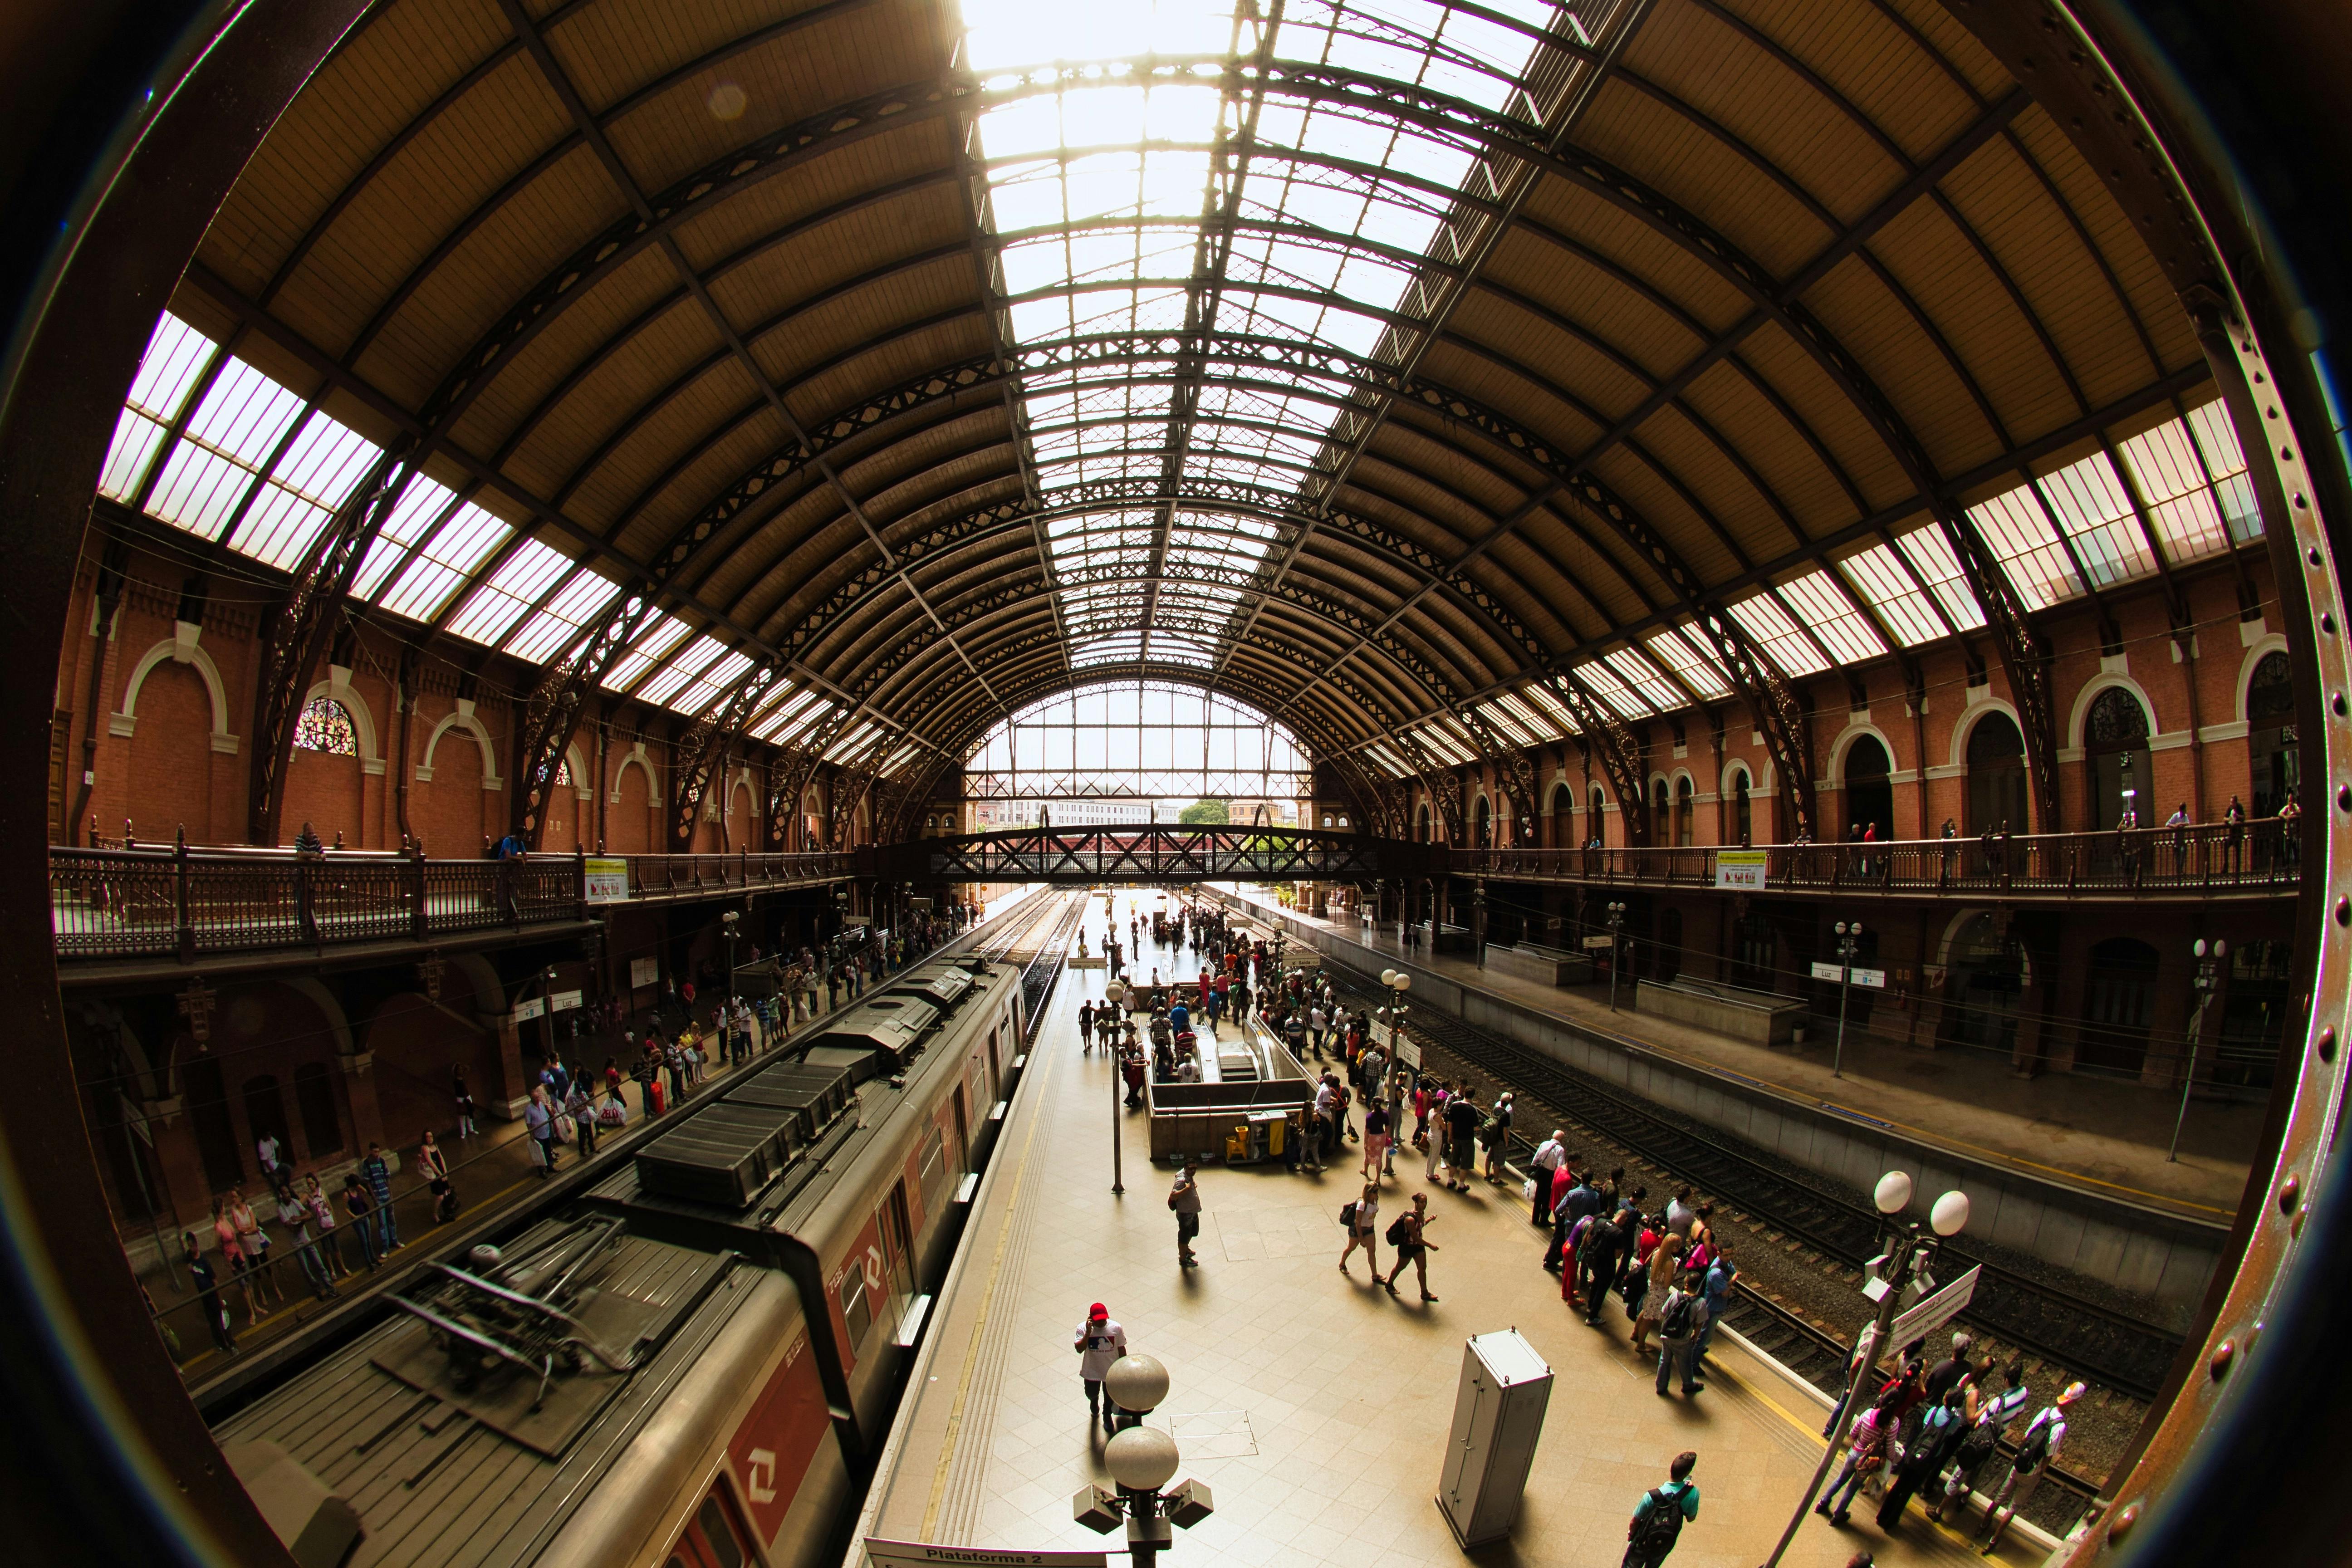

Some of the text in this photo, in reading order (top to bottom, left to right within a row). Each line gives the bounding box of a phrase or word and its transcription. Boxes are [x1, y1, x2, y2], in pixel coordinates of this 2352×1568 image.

[1404, 1049, 1412, 1061] Luz
[1898, 1301, 1936, 1328] Plataforma
[926, 1548, 1042, 1563] Plataforma 2
